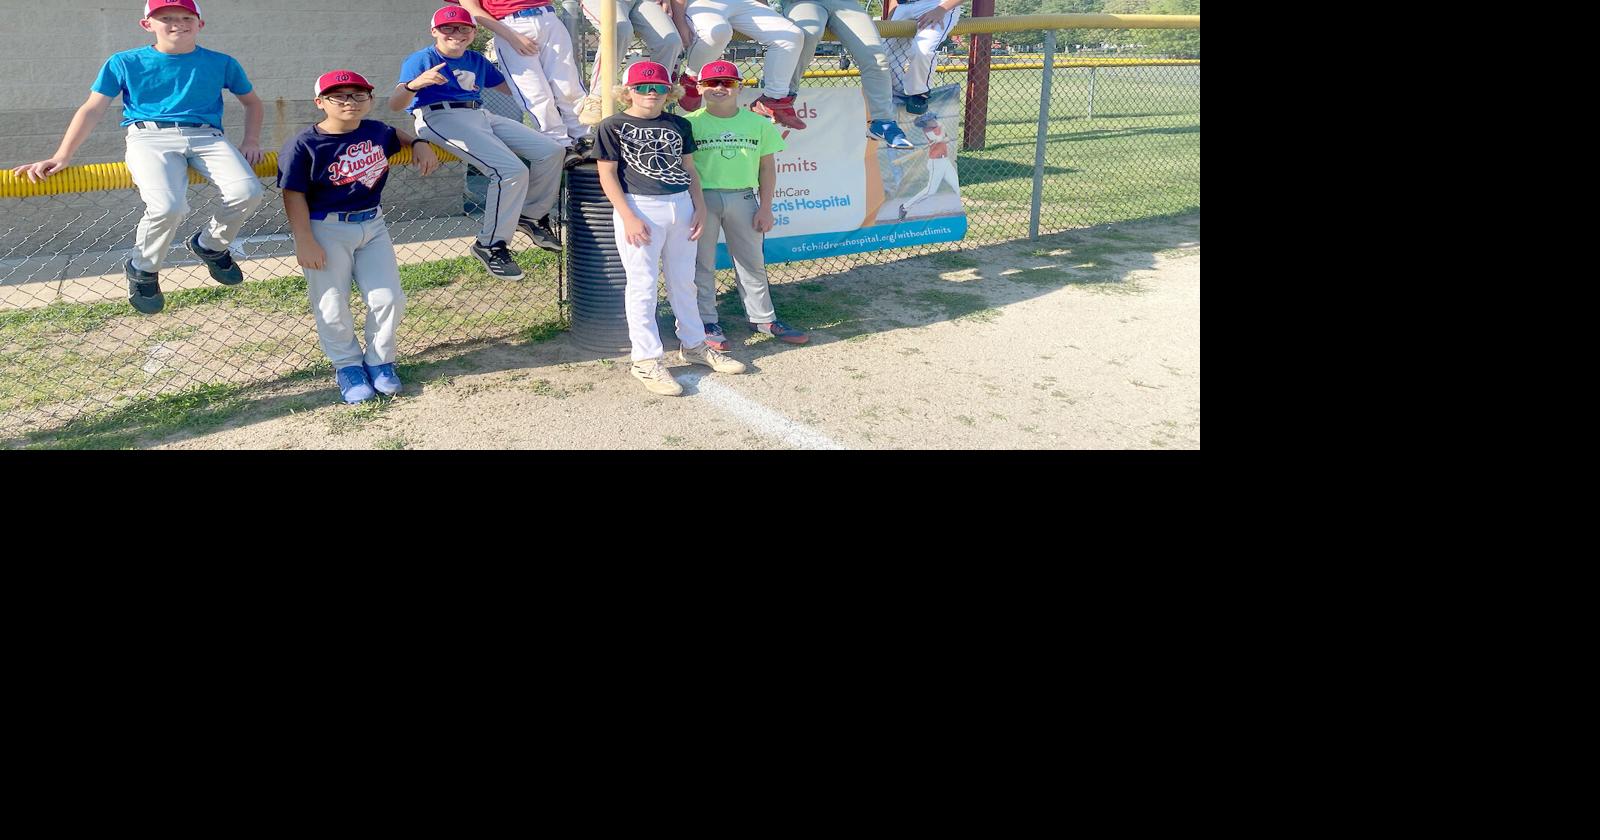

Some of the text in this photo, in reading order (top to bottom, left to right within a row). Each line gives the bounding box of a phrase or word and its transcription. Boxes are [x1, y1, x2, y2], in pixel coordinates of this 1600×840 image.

[797, 101, 818, 119] ds
[346, 140, 372, 158] CU
[777, 157, 818, 174] imits
[771, 194, 851, 212] en's Hospital
